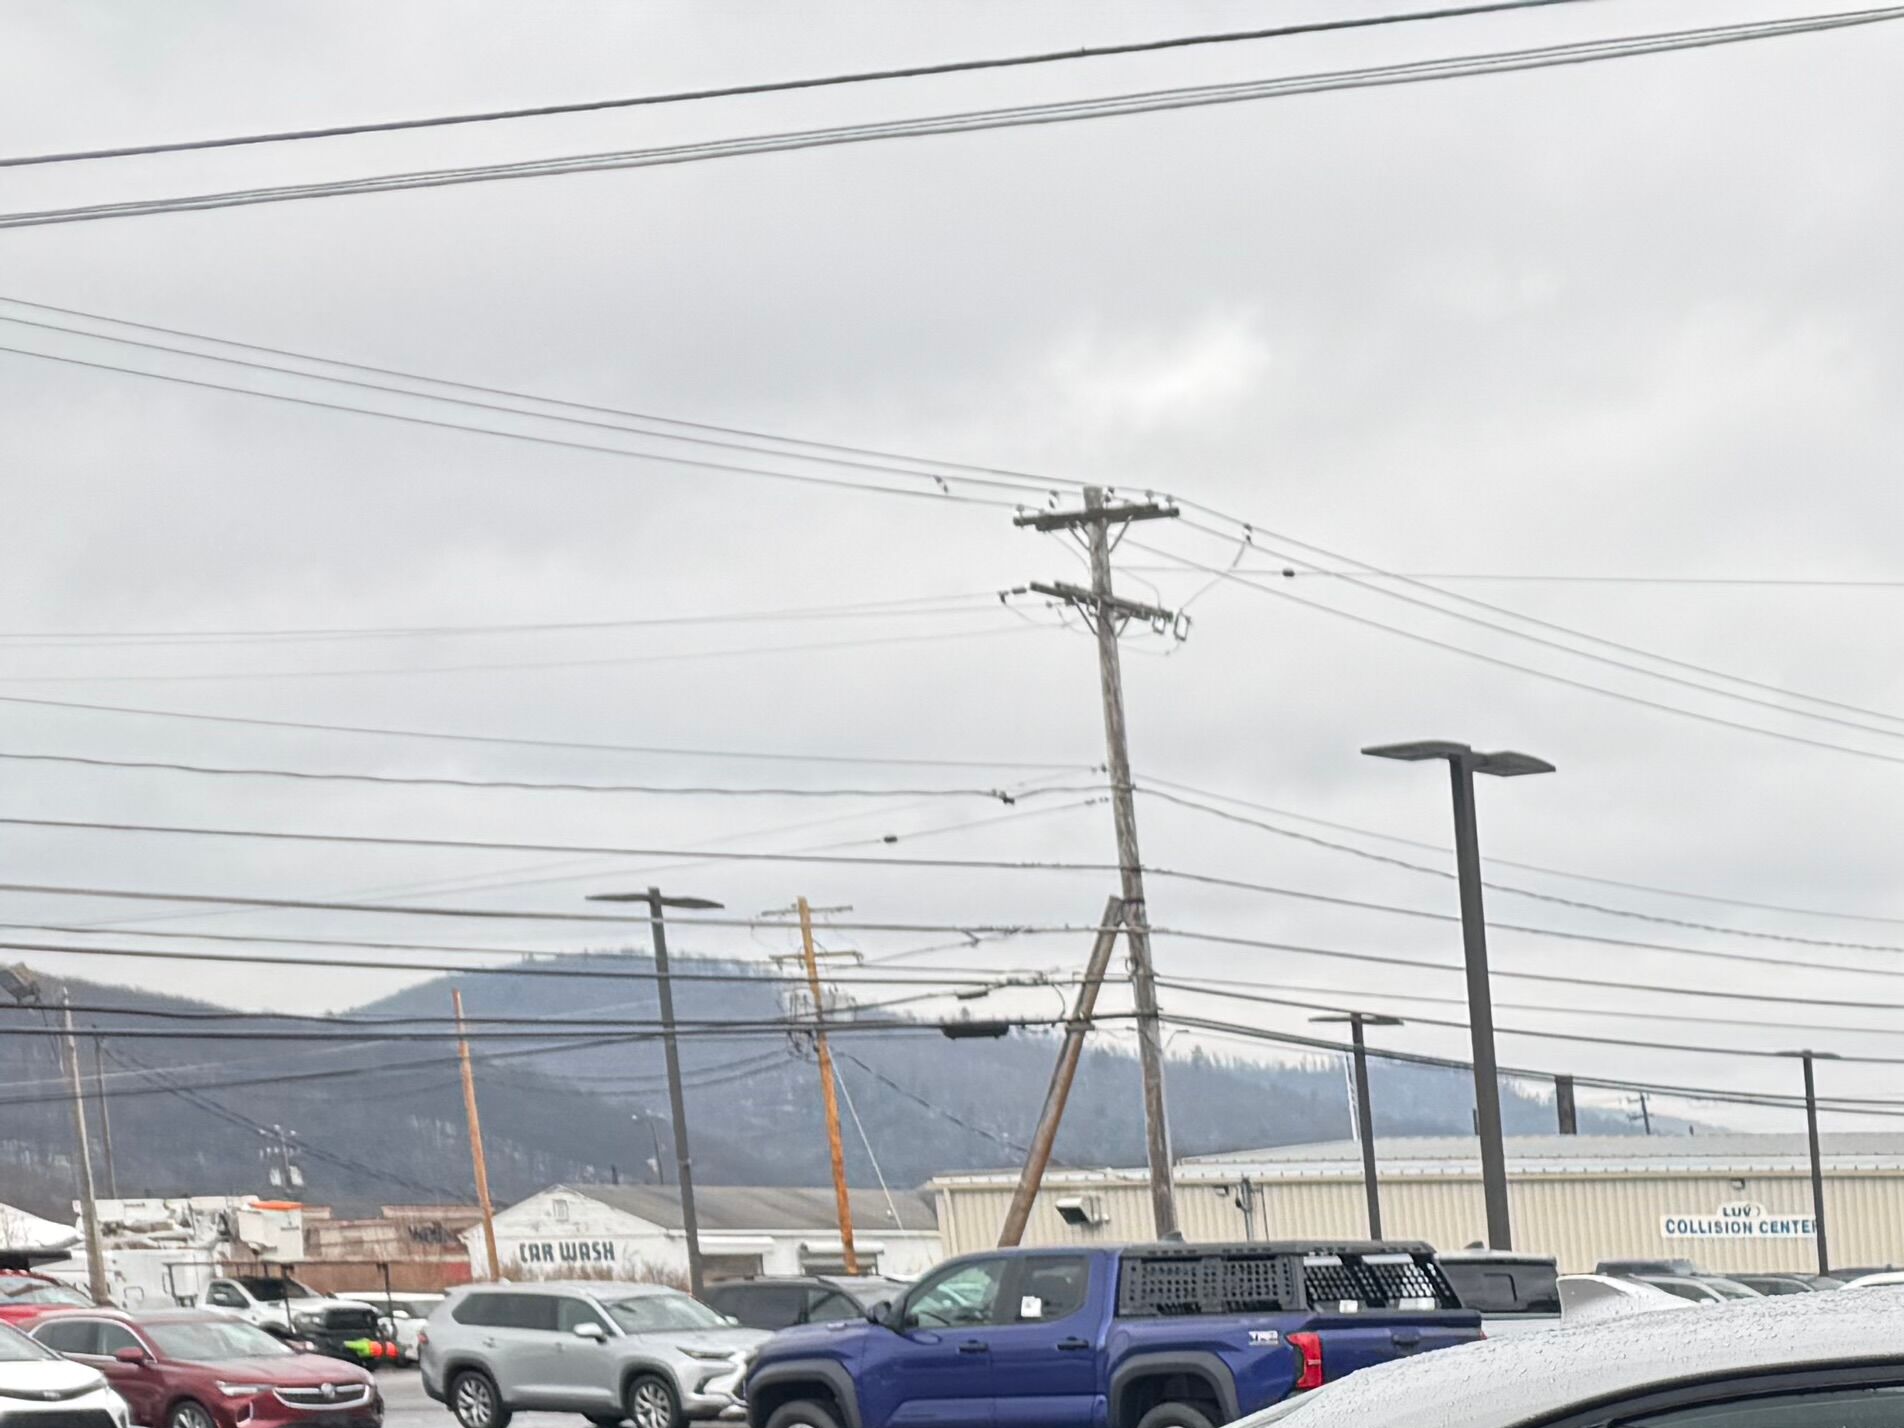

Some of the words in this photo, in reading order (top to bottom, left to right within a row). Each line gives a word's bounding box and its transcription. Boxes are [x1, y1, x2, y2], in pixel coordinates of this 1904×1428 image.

[1665, 1218, 1754, 1235] COLLISION
[519, 1242, 555, 1264] CAR
[559, 1240, 616, 1263] WASH
